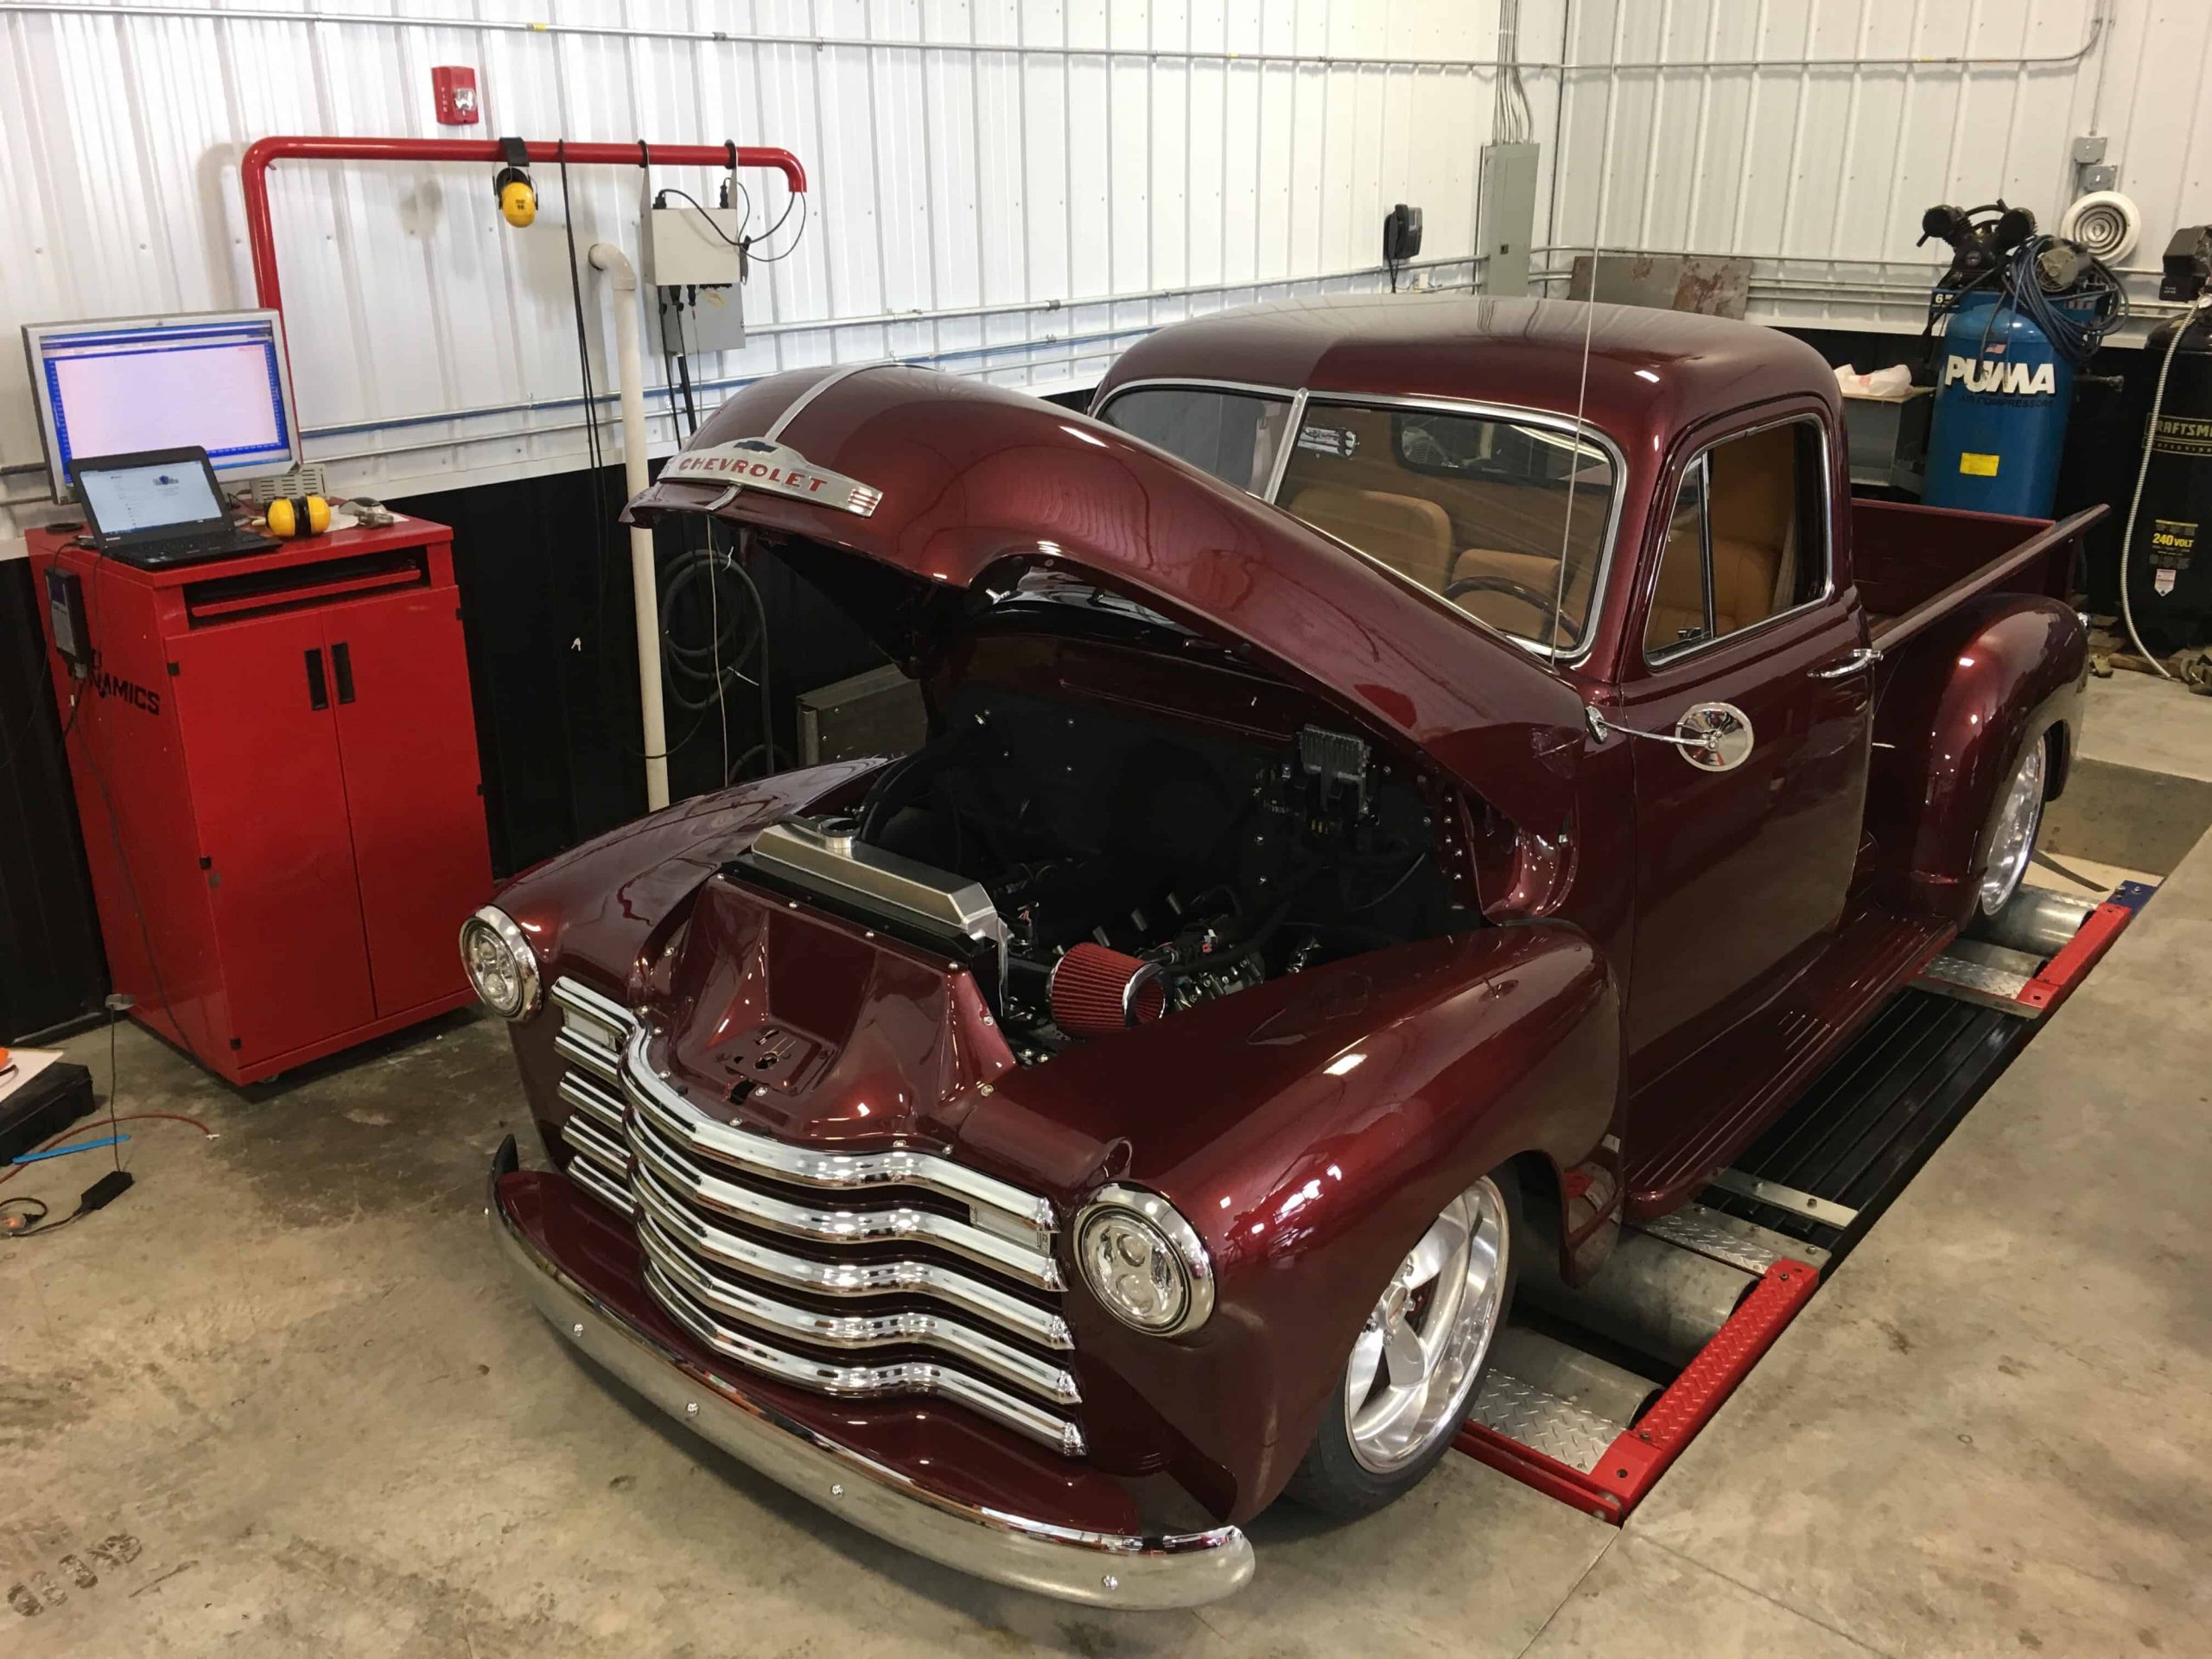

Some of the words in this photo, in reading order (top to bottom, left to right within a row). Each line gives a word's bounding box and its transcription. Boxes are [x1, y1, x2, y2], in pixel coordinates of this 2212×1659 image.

[1935, 293, 1943, 303] 6
[1944, 355, 2056, 394] PUMA
[2156, 420, 2212, 437] RAFTSM
[679, 458, 828, 493] CHEVROLET
[2152, 532, 2174, 546] 240
[2174, 537, 2195, 548] VOLT
[90, 668, 161, 716] NAMICS
